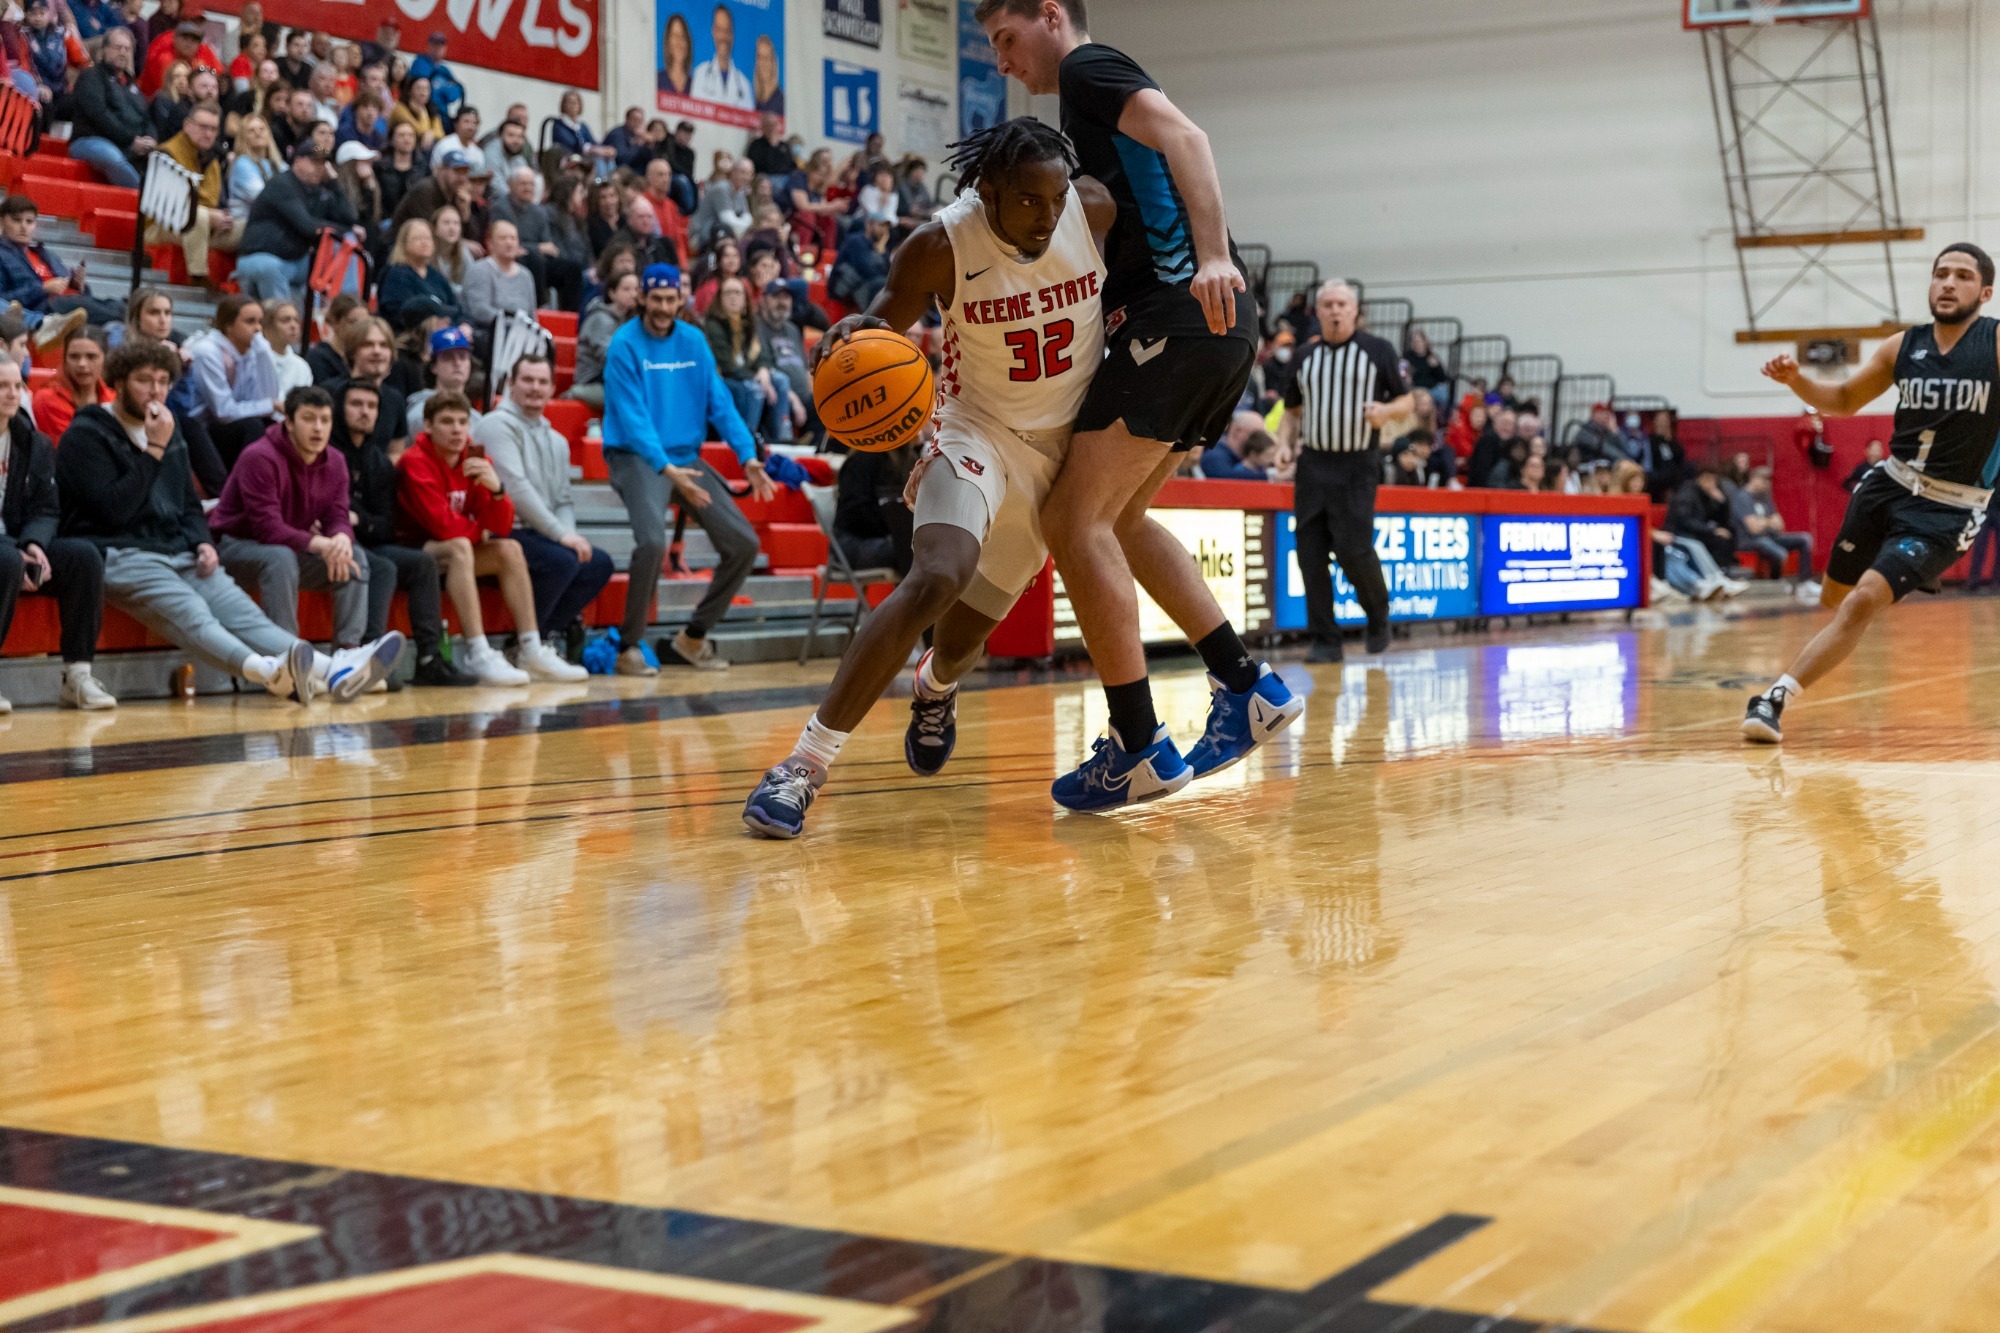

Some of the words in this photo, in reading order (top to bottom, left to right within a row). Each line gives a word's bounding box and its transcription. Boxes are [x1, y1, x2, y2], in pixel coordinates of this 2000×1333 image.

[963, 292, 1035, 324] KEENE
[1038, 270, 1099, 314] STATE
[1004, 318, 1075, 382] 32
[1900, 377, 1991, 415] BOSTON
[1409, 516, 1470, 561] TEES
[1395, 561, 1470, 591] PRINTING
